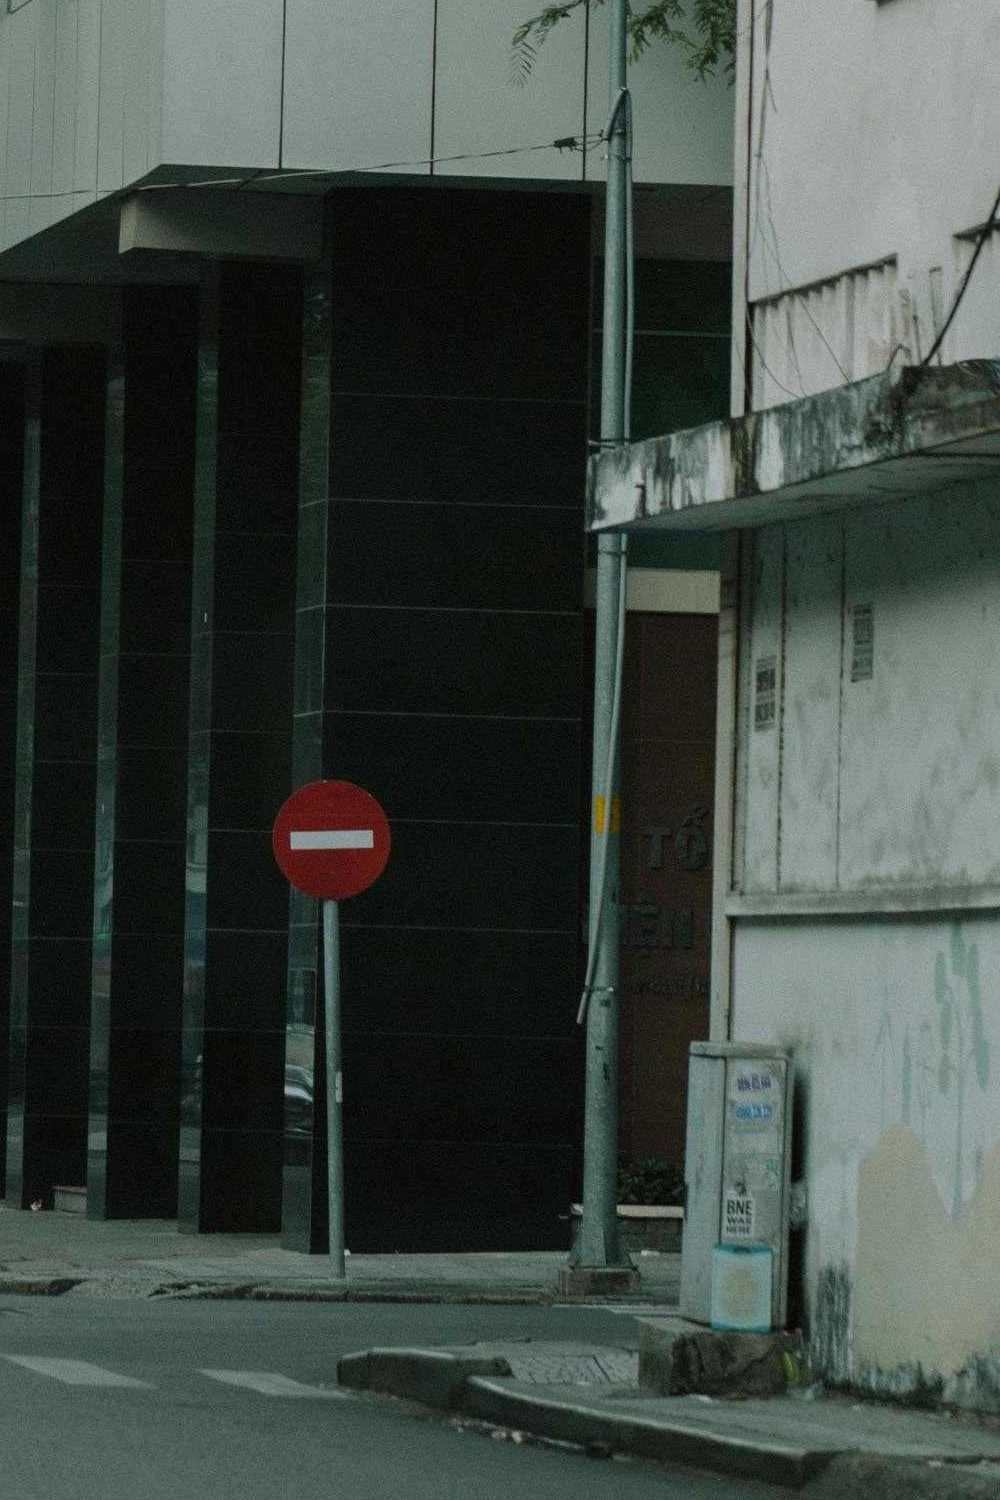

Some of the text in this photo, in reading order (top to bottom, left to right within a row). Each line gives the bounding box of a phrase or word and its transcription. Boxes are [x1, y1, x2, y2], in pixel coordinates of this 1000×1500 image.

[727, 1199, 753, 1215] BNE
[727, 1216, 752, 1224] WAS
[726, 1226, 751, 1234] HERE
